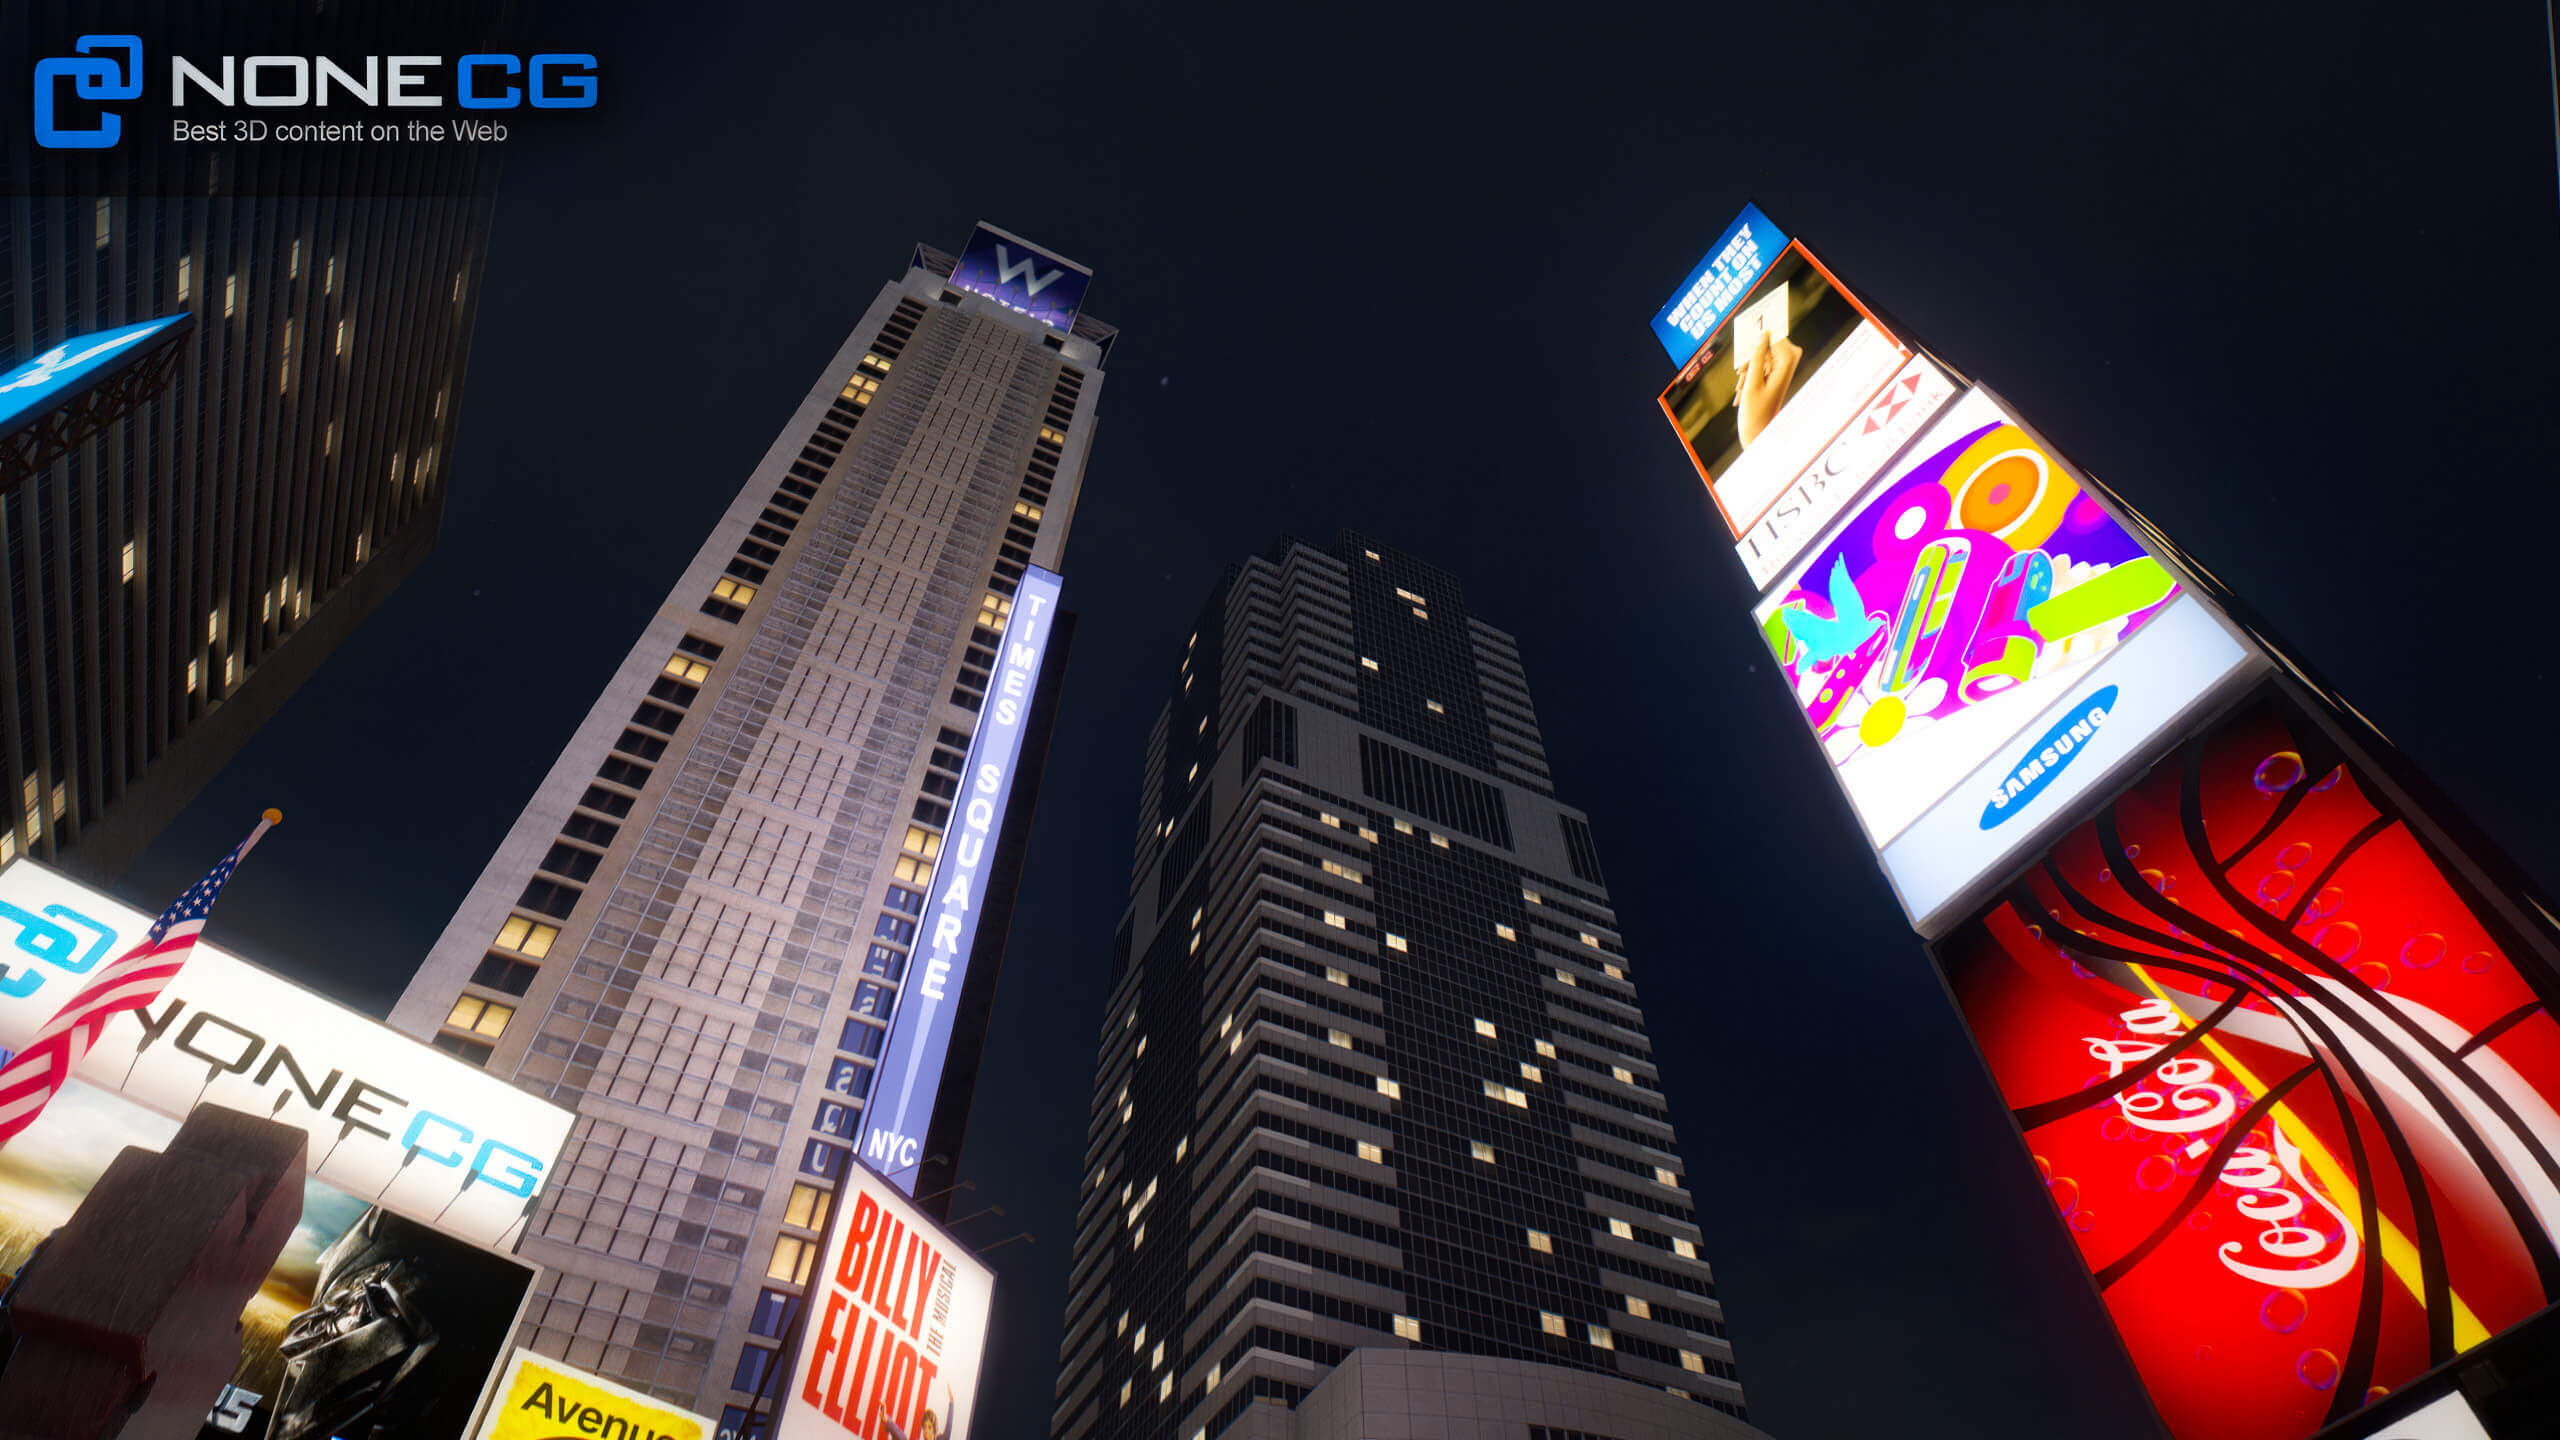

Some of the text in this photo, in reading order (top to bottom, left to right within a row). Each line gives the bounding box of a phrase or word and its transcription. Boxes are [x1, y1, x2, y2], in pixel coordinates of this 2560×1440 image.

[996, 243, 1064, 297] W
[1666, 269, 1715, 327] WHEN
[1711, 222, 1752, 271] THEY
[1679, 267, 1732, 334] COUNT
[1731, 238, 1759, 271] ON
[1690, 309, 1717, 340] US
[1713, 253, 1762, 313] MOST
[920, 593, 1047, 1001] TIMES SQUARE
[1991, 707, 2108, 808] SAMSUNG
[867, 1128, 917, 1167] NYC
[835, 1189, 942, 1342] BILLY
[926, 1258, 957, 1357] THE MUSICAL
[521, 1382, 677, 1440] Avenu
[802, 1289, 938, 1440] ELLIOT
